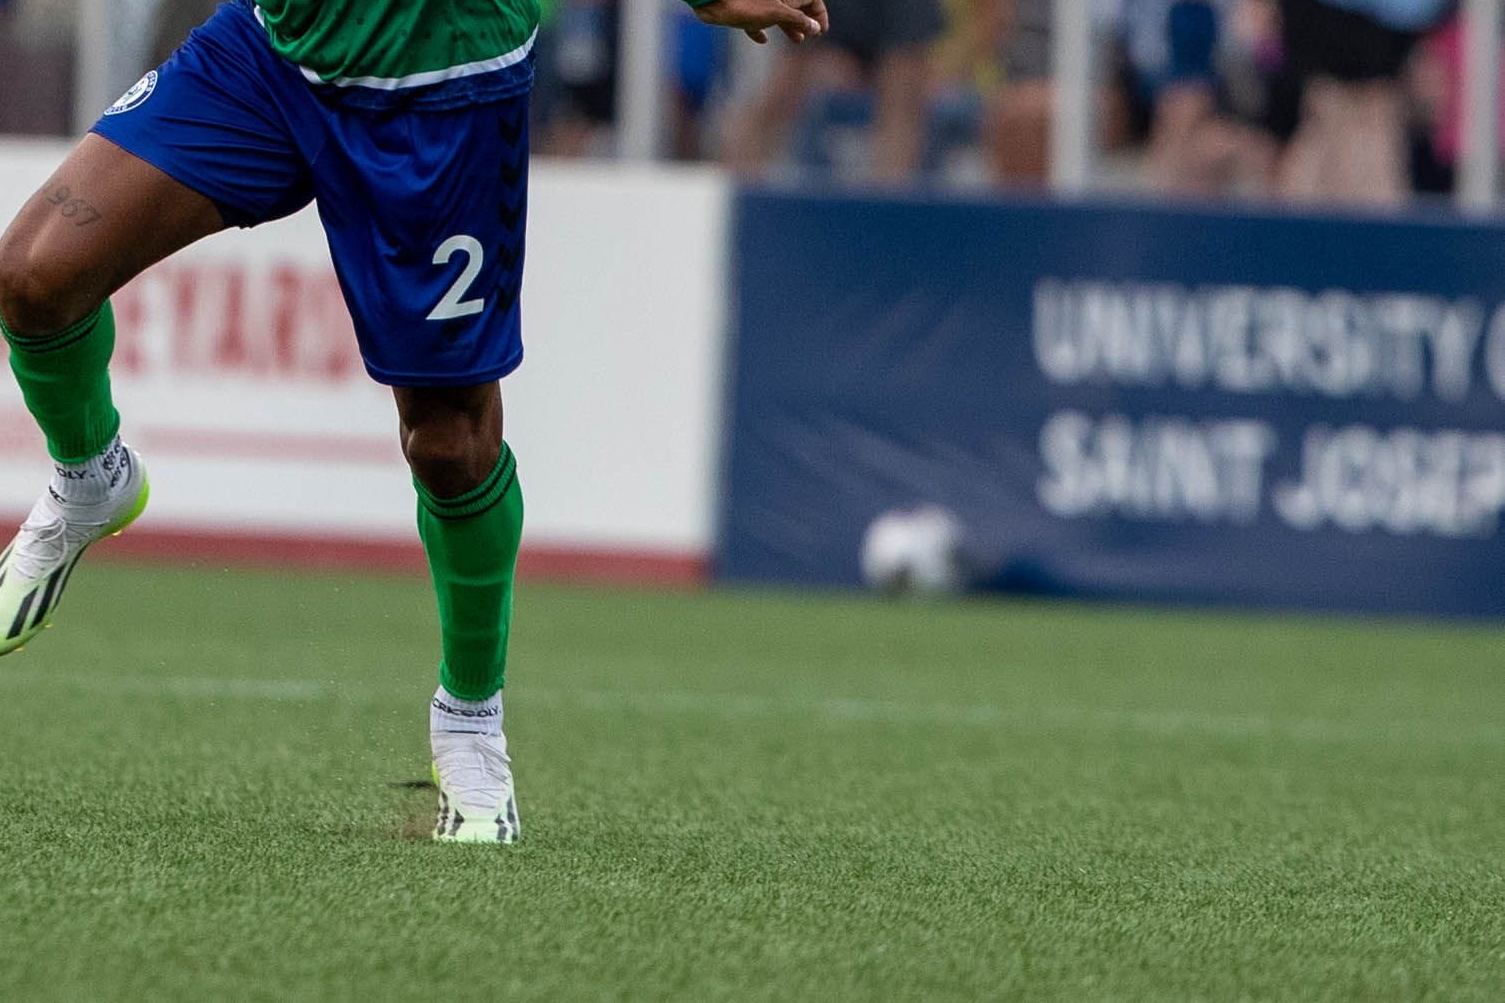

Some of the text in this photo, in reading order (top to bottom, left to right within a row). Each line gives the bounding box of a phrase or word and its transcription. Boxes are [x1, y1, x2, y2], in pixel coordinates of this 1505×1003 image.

[425, 234, 485, 320] 2
[1032, 280, 1484, 399] UNIVERSITY
[1036, 410, 1276, 523] SAINT
